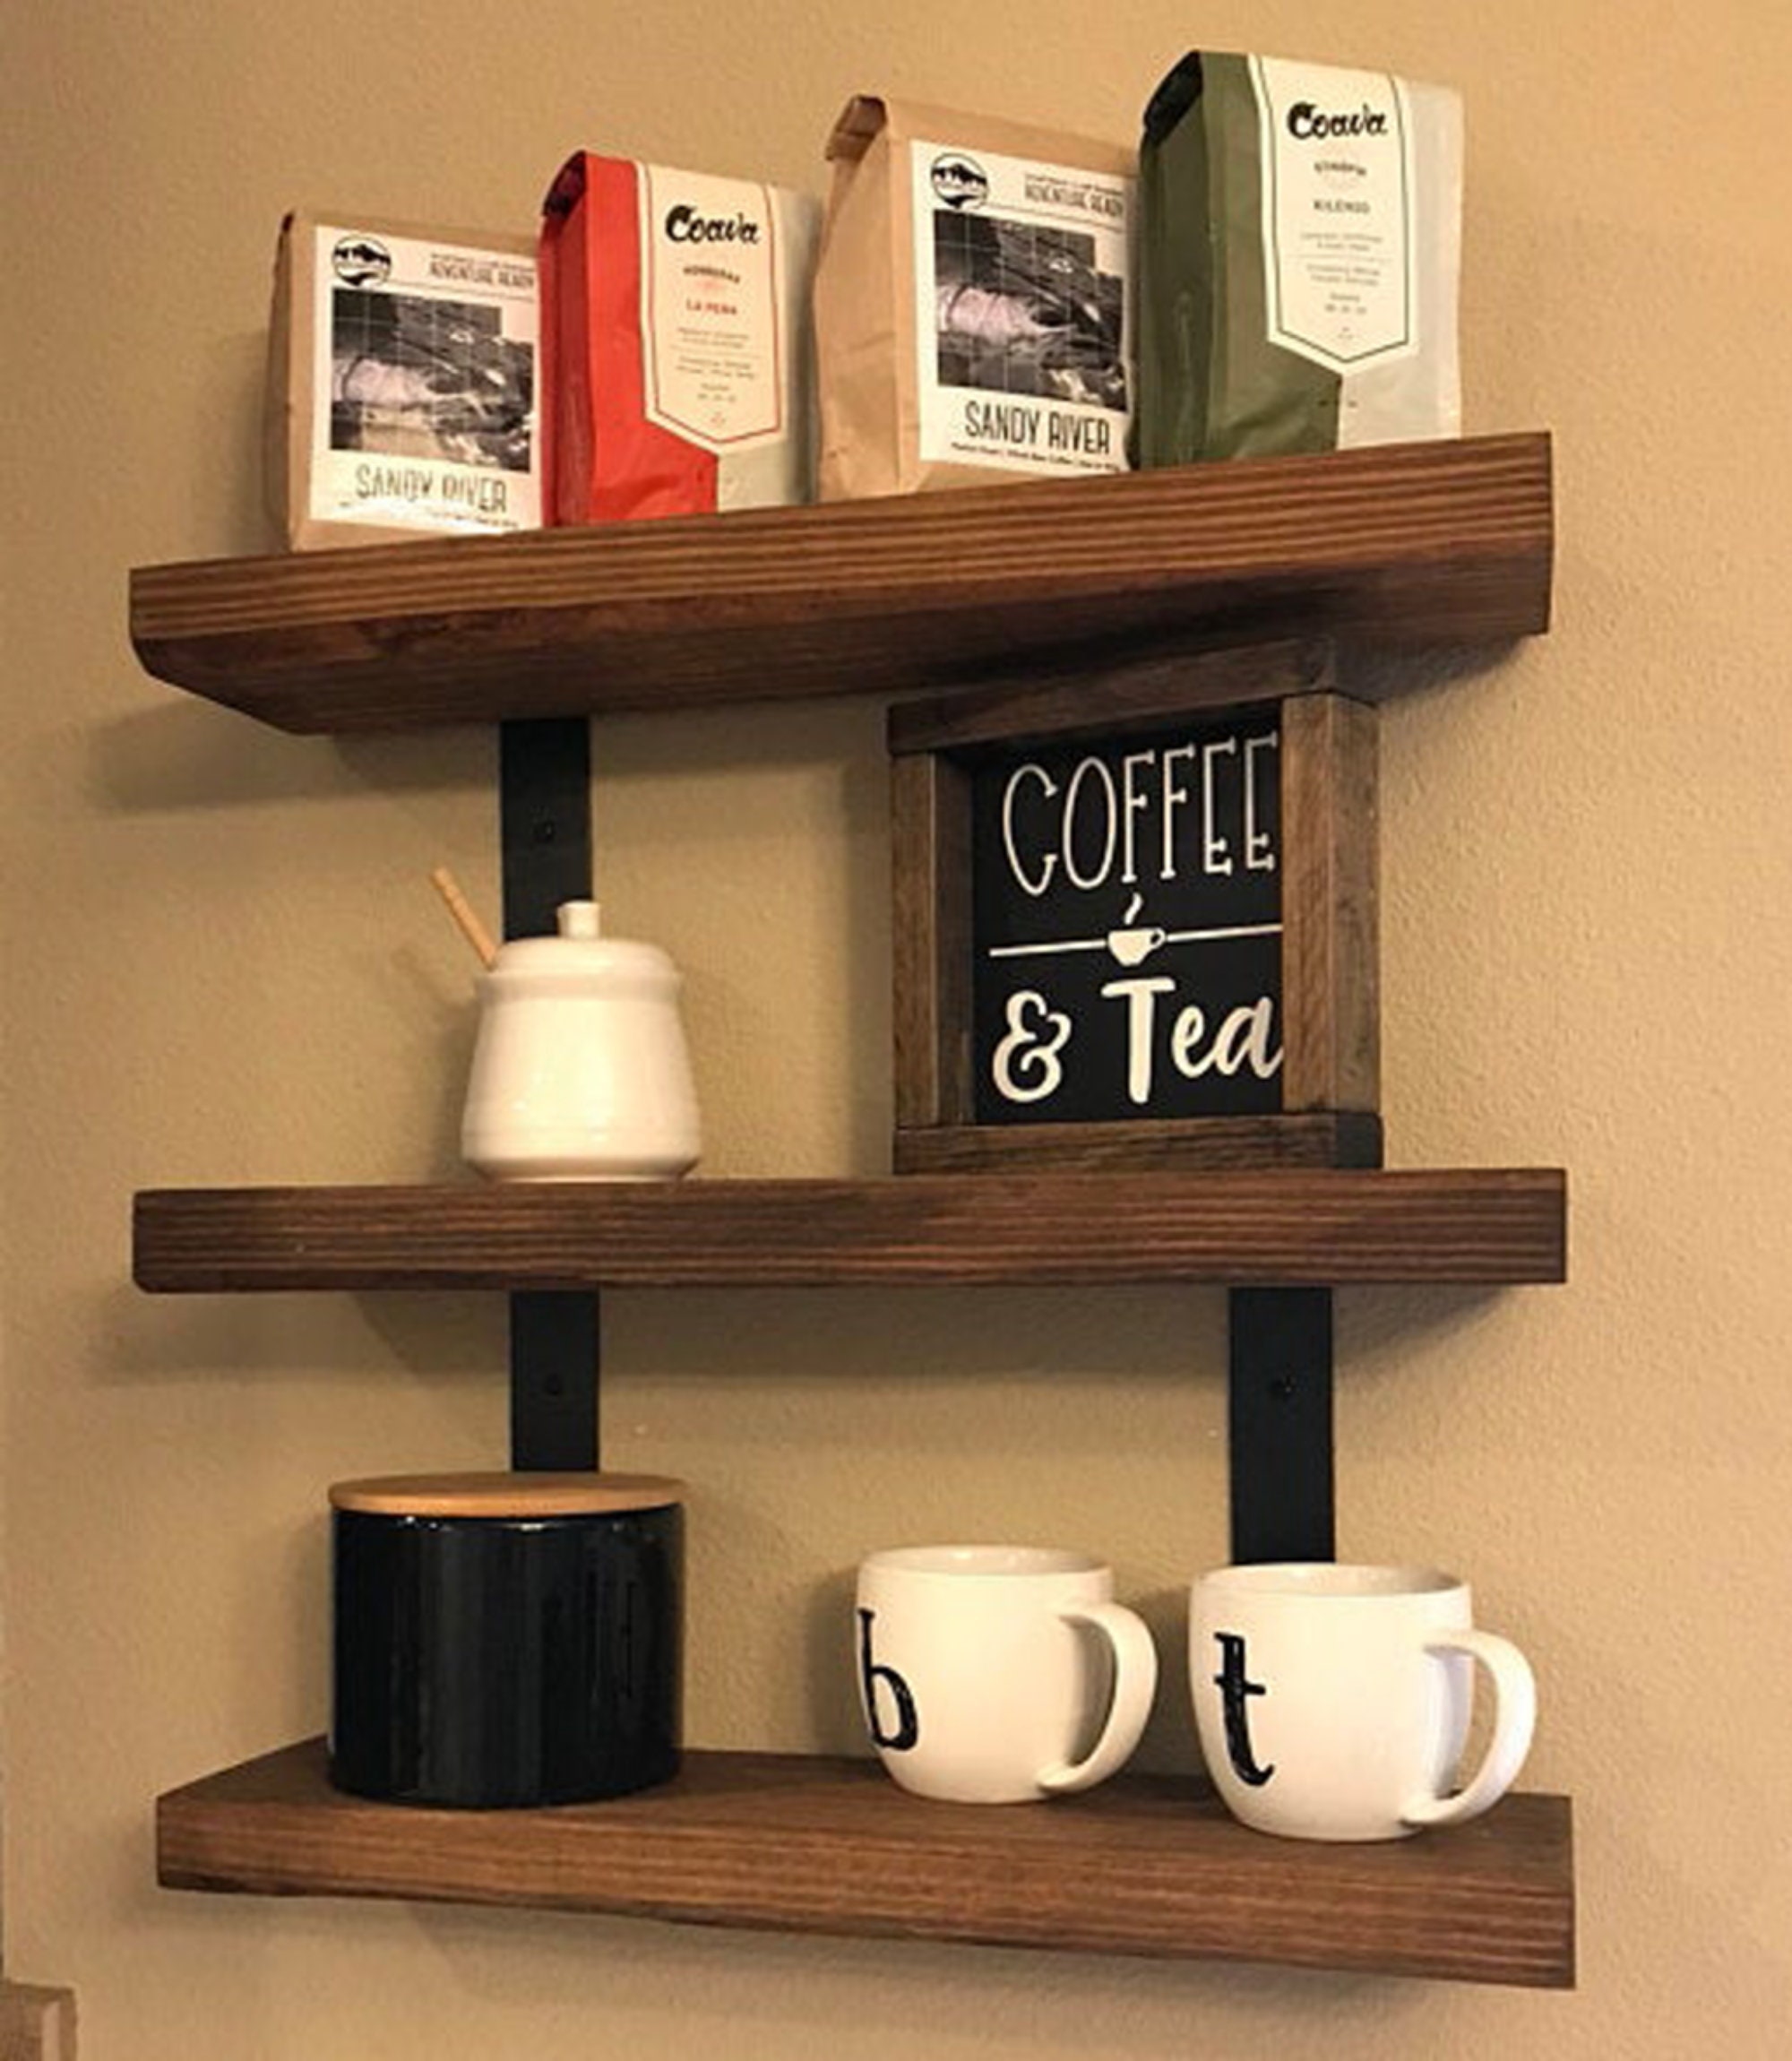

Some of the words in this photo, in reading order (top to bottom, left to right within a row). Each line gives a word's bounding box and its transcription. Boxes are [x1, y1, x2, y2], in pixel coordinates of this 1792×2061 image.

[1287, 101, 1388, 139] Coava
[666, 204, 761, 244] Coava
[965, 401, 1040, 445] SANDY
[1048, 410, 1111, 455] RIVER
[356, 464, 433, 502] SANDY
[1003, 731, 1279, 896] COFFEE
[992, 990, 1073, 1103] &
[1100, 977, 1283, 1104] Tea
[857, 1608, 918, 1751] b
[1214, 1631, 1274, 1787] t
